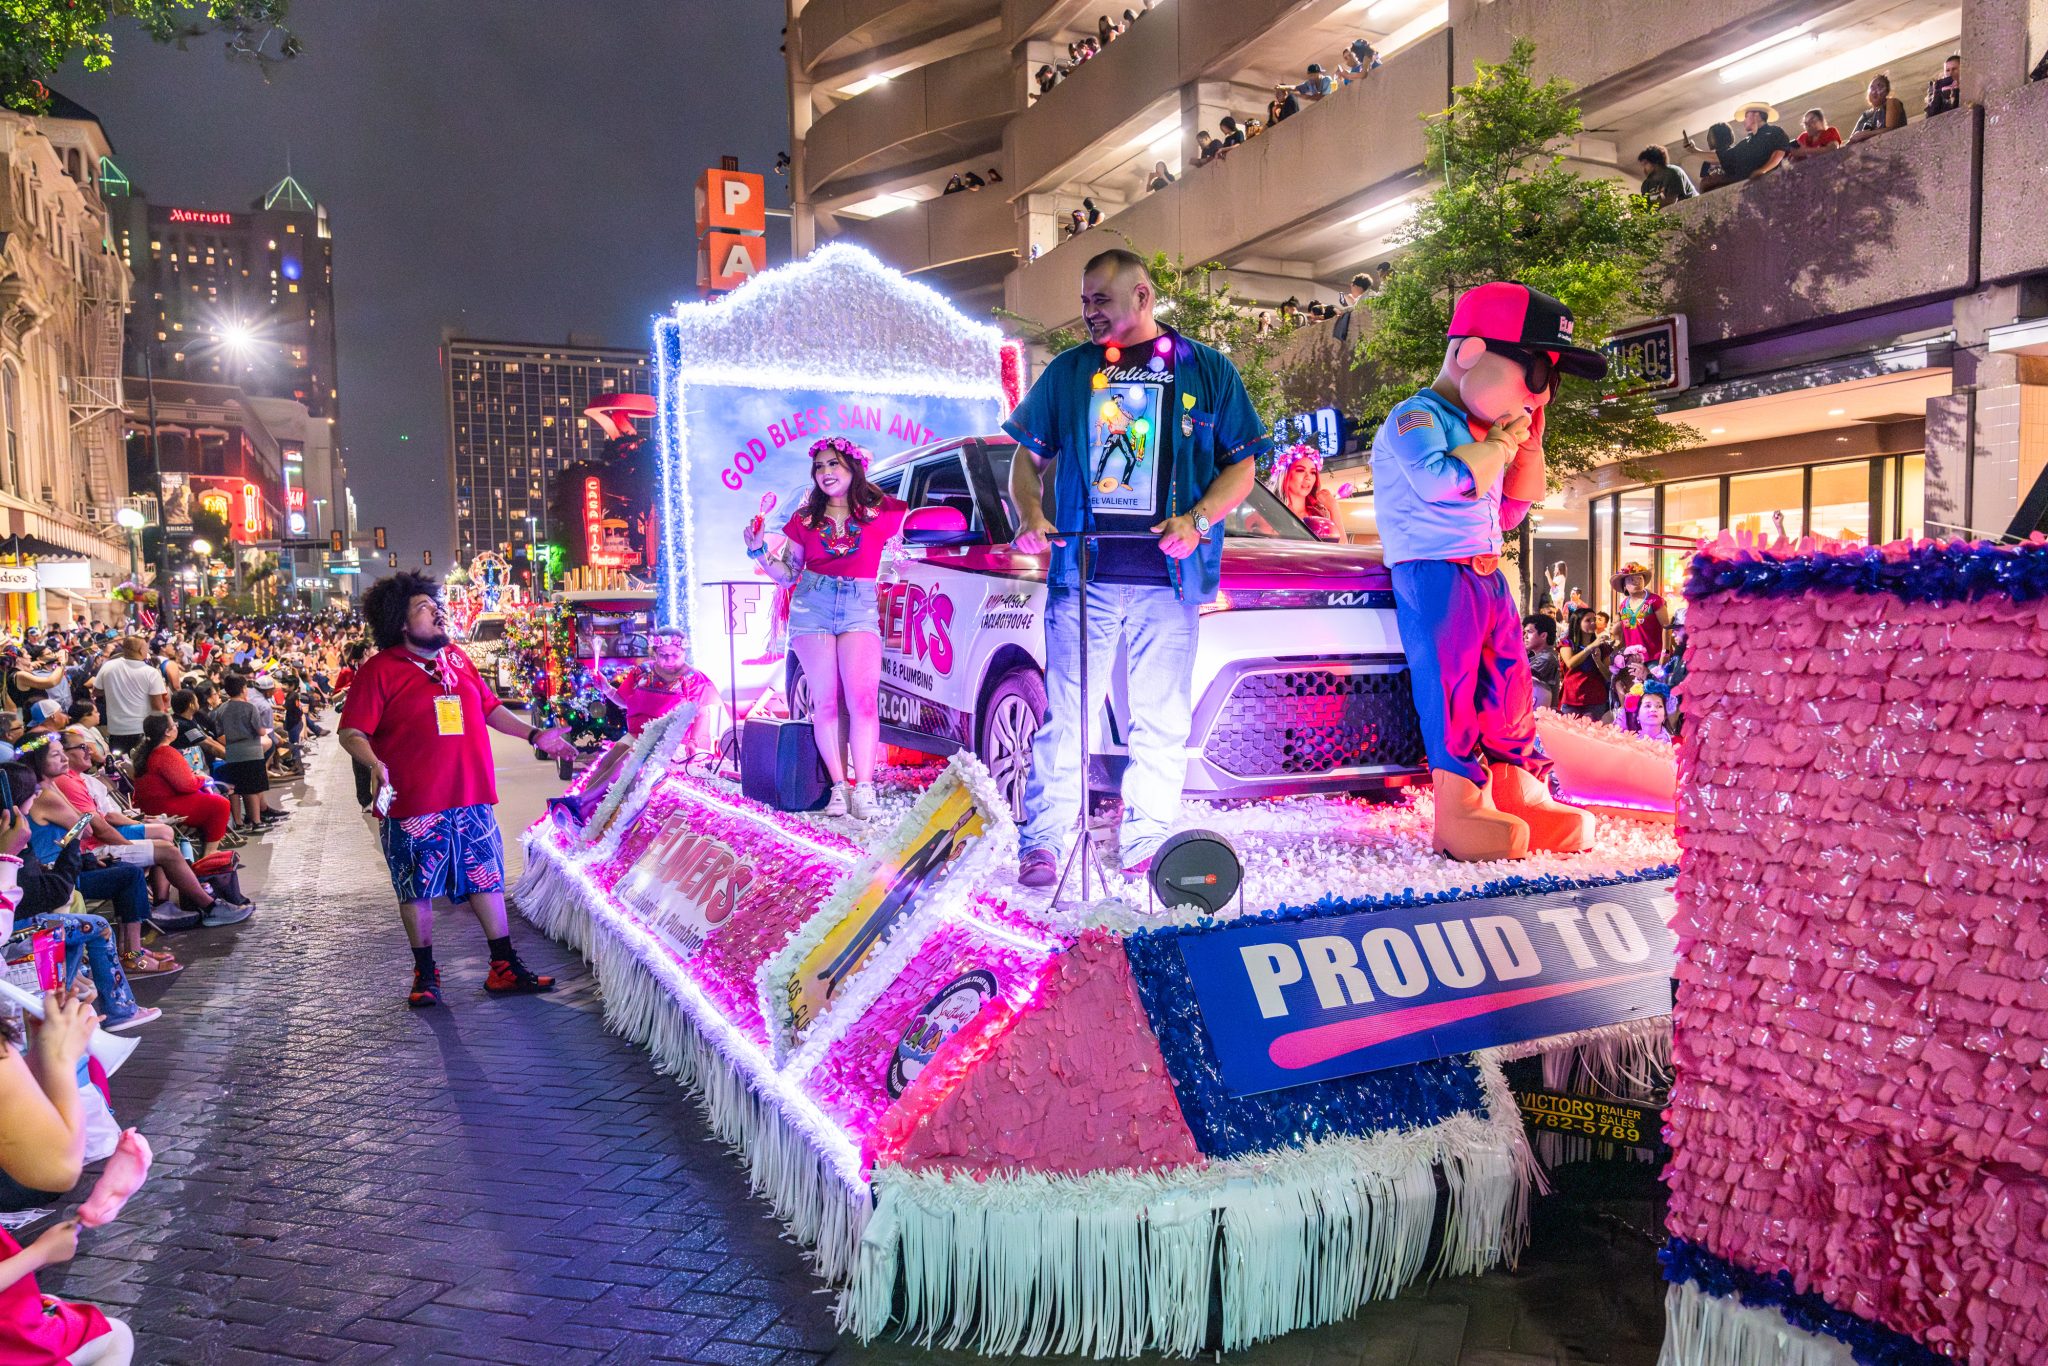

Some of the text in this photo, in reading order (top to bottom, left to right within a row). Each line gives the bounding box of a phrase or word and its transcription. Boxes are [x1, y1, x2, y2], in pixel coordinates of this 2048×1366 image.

[170, 209, 231, 224] Marriott
[1103, 365, 1174, 383] Valiente
[721, 438, 767, 491] GOD
[767, 405, 831, 449] BLESS
[837, 404, 881, 432] SAN
[1101, 497, 1138, 506] VALIENTE
[588, 481, 601, 552] CASA RIO
[1328, 593, 1369, 605] KIA
[899, 665, 934, 692] PLUMBING
[879, 694, 921, 726] R.COM
[664, 911, 705, 958] Plumbing
[1239, 903, 1651, 1019] PROUD TO
[1520, 1092, 1641, 1121] VICTORS TRAILER
[1600, 1115, 1636, 1129] SALES
